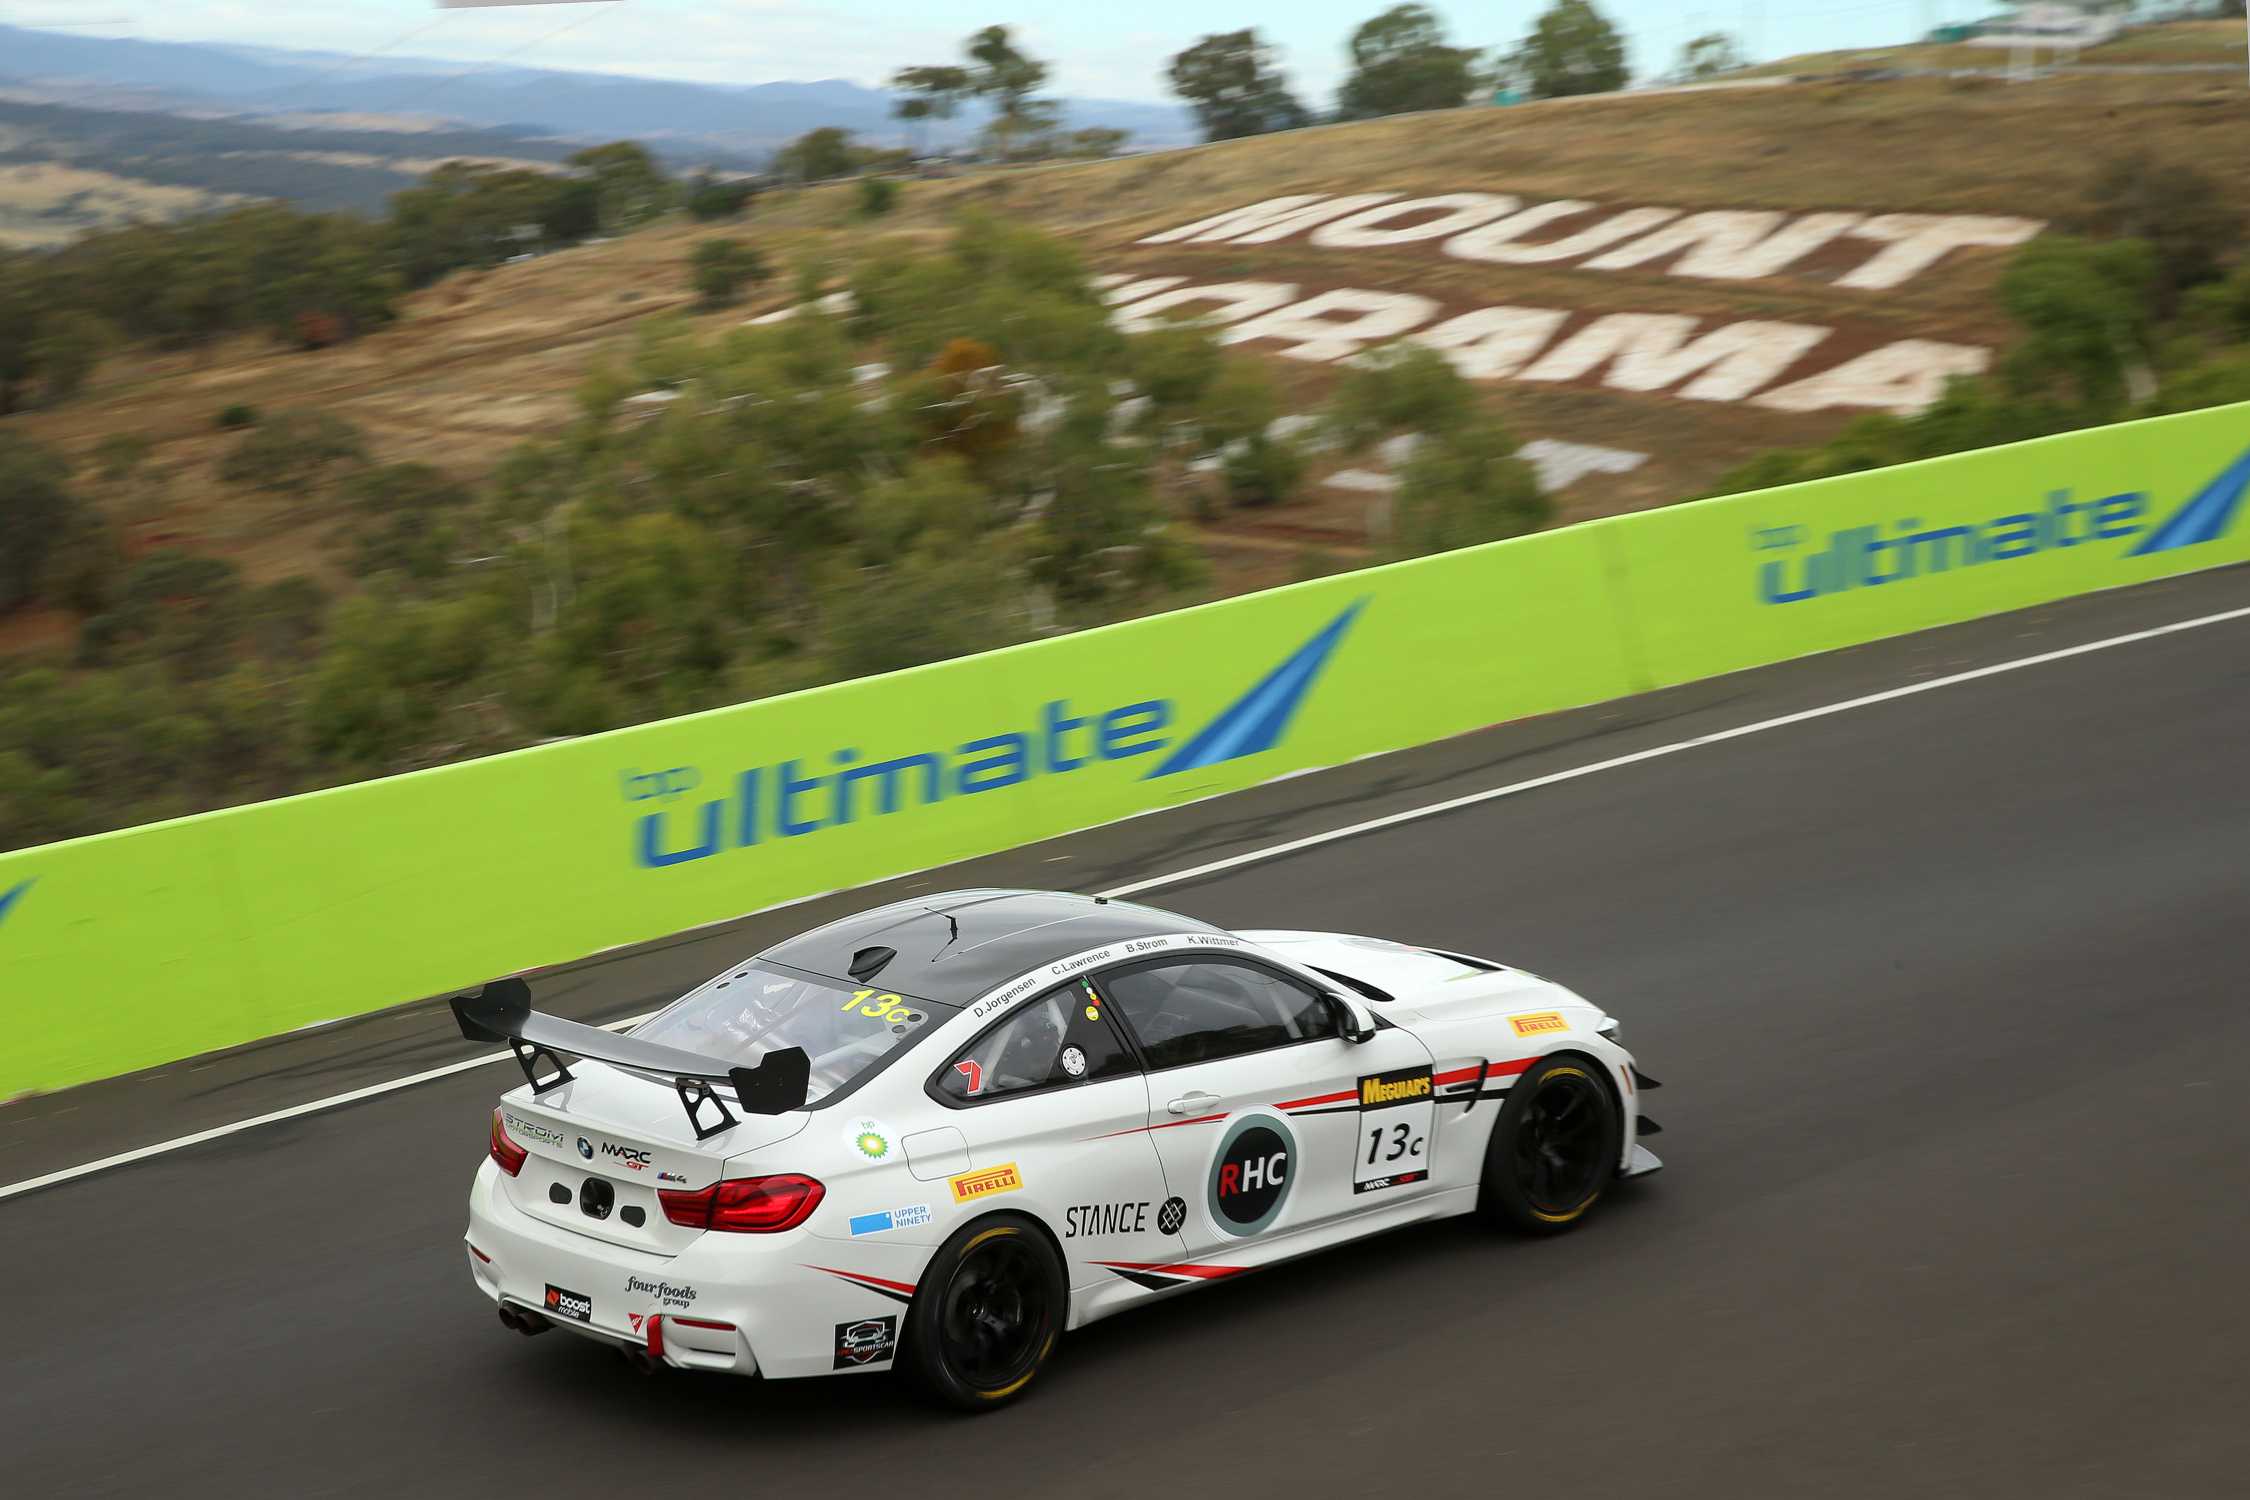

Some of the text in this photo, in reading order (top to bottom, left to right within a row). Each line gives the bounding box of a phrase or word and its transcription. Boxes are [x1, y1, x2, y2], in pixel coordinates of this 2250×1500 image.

[1136, 191, 2044, 290] MOUNT
[635, 698, 1176, 868] ultimate
[1125, 937, 1168, 954] B.Strom
[1187, 934, 1240, 947] K.Wittmer
[1051, 949, 1111, 976] C.Lawrence
[841, 989, 911, 1023] 13c
[973, 977, 1036, 1019] D.Jorgensen
[1514, 1015, 1563, 1033] PIRELLI
[601, 1142, 652, 1164] MARC
[1368, 1123, 1424, 1164] 13c
[955, 1168, 1016, 1197] PIRELLI
[1220, 1152, 1287, 1198] RHC
[894, 1206, 927, 1219] UPPER
[896, 1213, 931, 1228] NINETY
[1065, 1202, 1150, 1238] STANCE
[560, 1293, 590, 1314] boost
[662, 1298, 690, 1309] group
